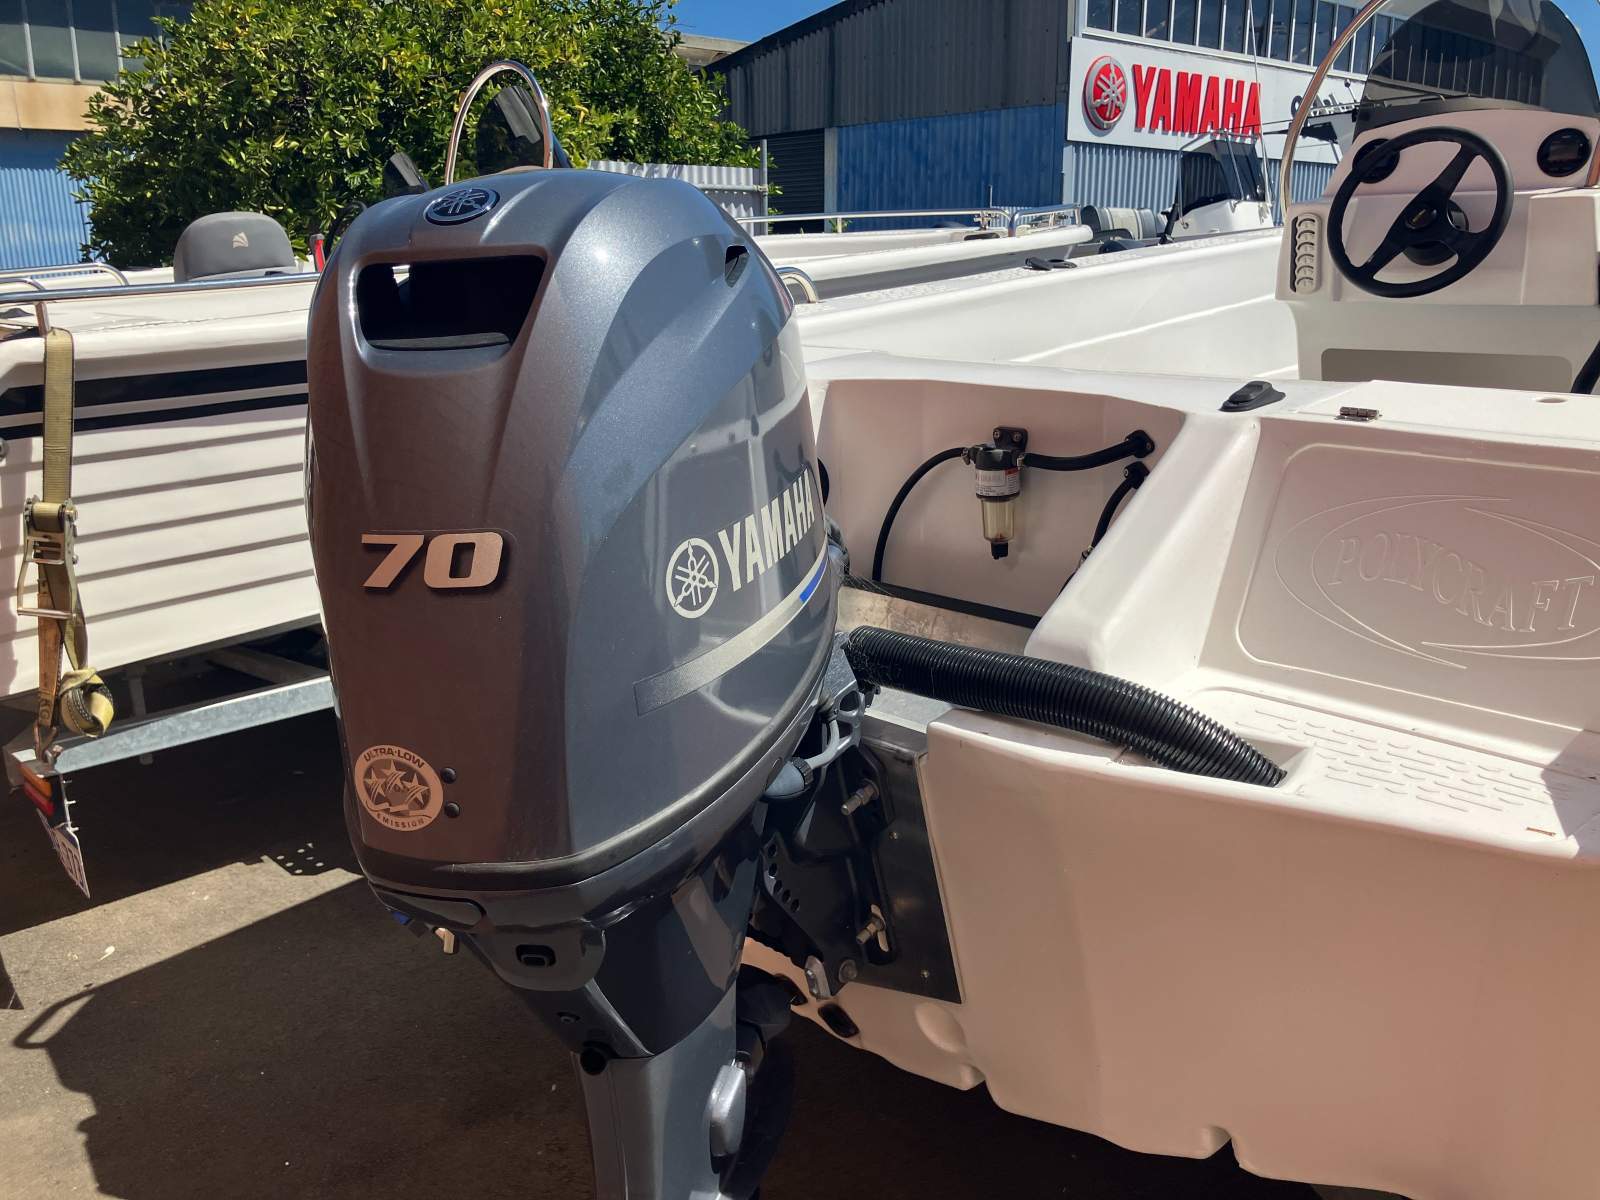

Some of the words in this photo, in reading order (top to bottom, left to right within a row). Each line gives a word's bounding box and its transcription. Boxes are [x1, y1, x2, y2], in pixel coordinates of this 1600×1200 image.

[1132, 64, 1261, 136] YAMAHA
[361, 532, 503, 588] 70
[718, 468, 815, 592] YAMAHA
[1328, 533, 1594, 632] POLYCRAFT
[376, 812, 424, 829] EMISSION
